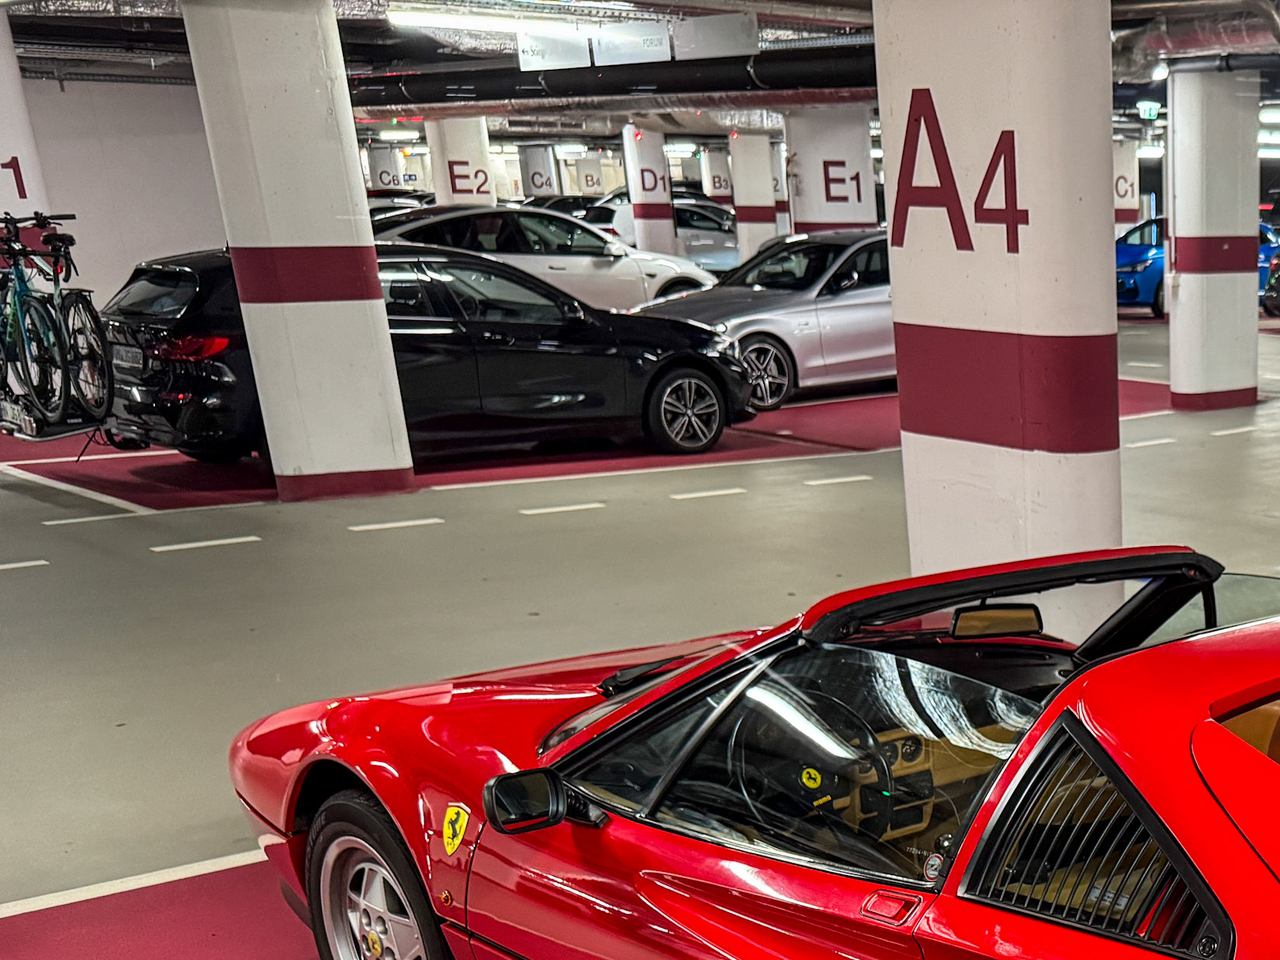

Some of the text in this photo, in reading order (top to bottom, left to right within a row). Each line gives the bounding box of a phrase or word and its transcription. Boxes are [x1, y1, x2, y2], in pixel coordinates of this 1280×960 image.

[642, 37, 664, 49] FORUM
[0, 156, 28, 199] 1
[379, 170, 400, 186] C6
[448, 160, 491, 195] E2
[531, 172, 553, 190] C4
[585, 174, 601, 188] B4
[640, 168, 667, 192] D1
[891, 88, 1029, 254] A4
[712, 175, 729, 190] B3
[773, 177, 780, 192] 2
[823, 160, 862, 203] E1
[1115, 175, 1135, 198] C1
